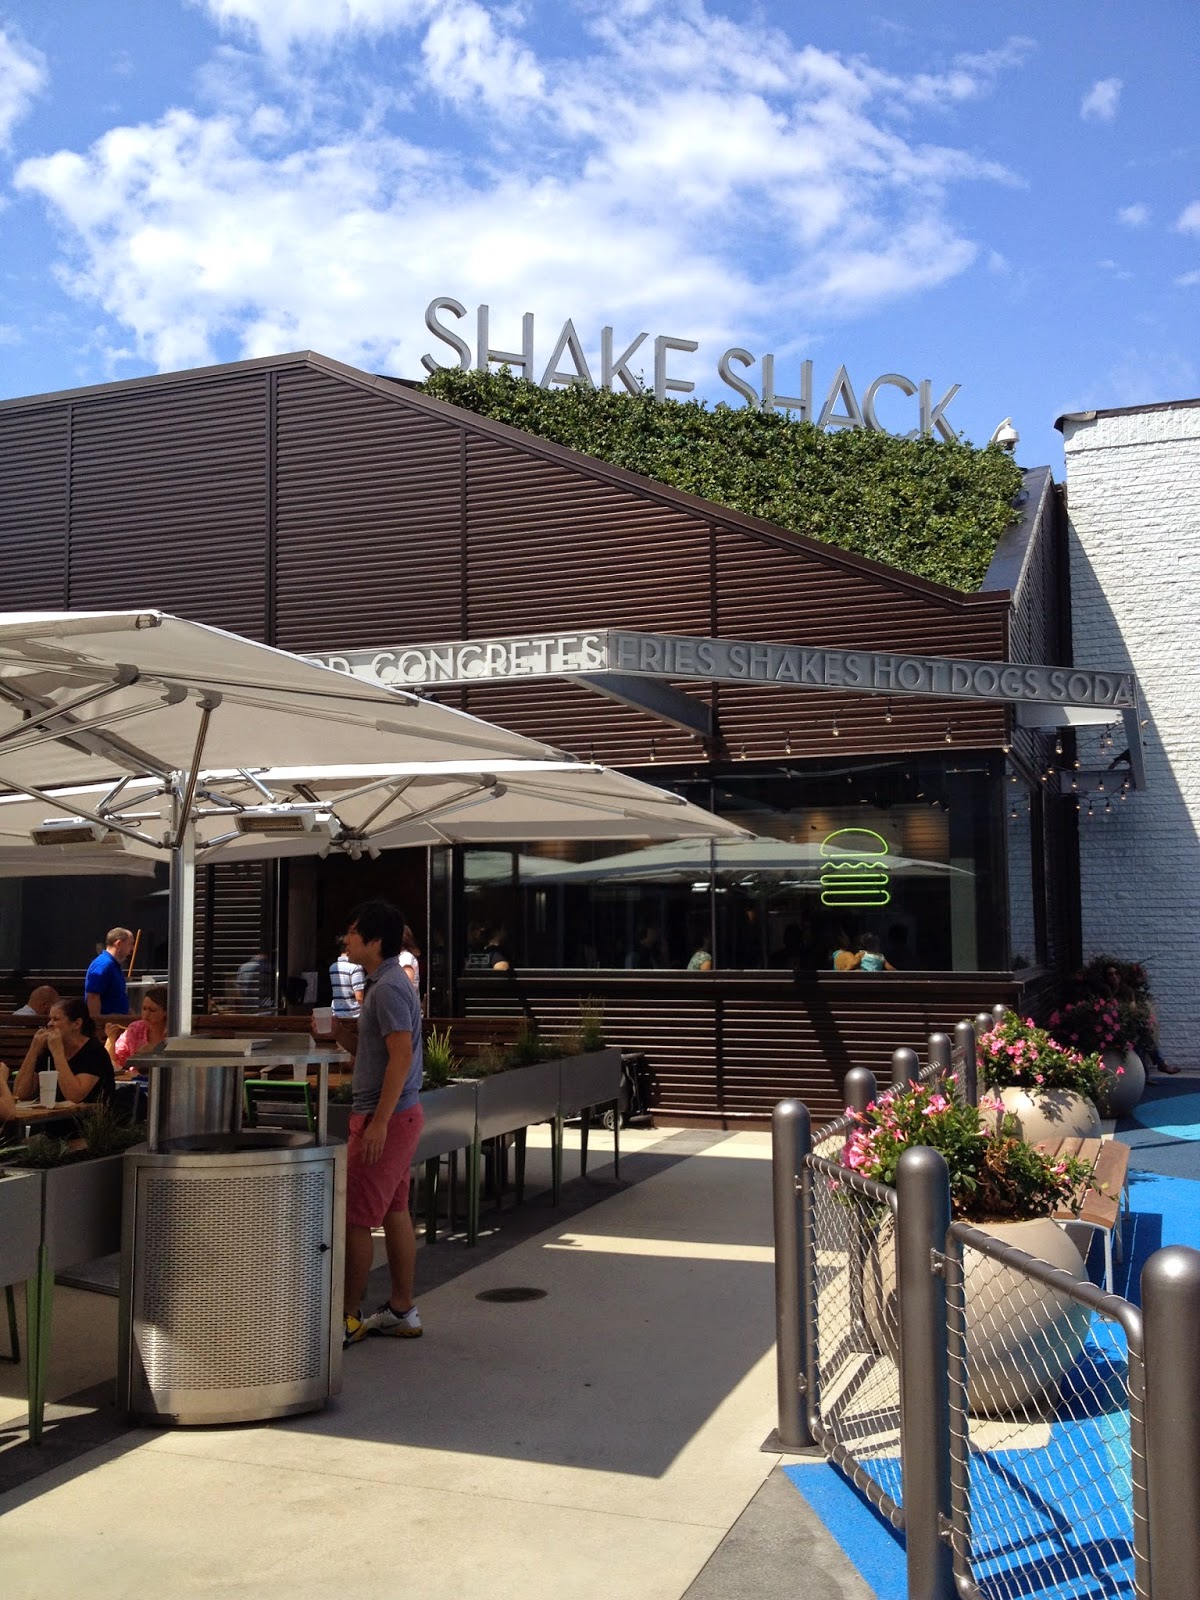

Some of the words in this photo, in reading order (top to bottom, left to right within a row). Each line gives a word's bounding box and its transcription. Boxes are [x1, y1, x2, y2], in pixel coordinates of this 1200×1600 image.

[420, 296, 699, 402] SHAKE
[715, 347, 963, 443] SHACK
[370, 635, 602, 684] CONCRETES
[617, 636, 716, 675] FRIES
[728, 645, 861, 687] SHAKES
[873, 656, 947, 692] HOT
[951, 663, 1040, 700] DOGS
[1049, 670, 1133, 705] SODA
